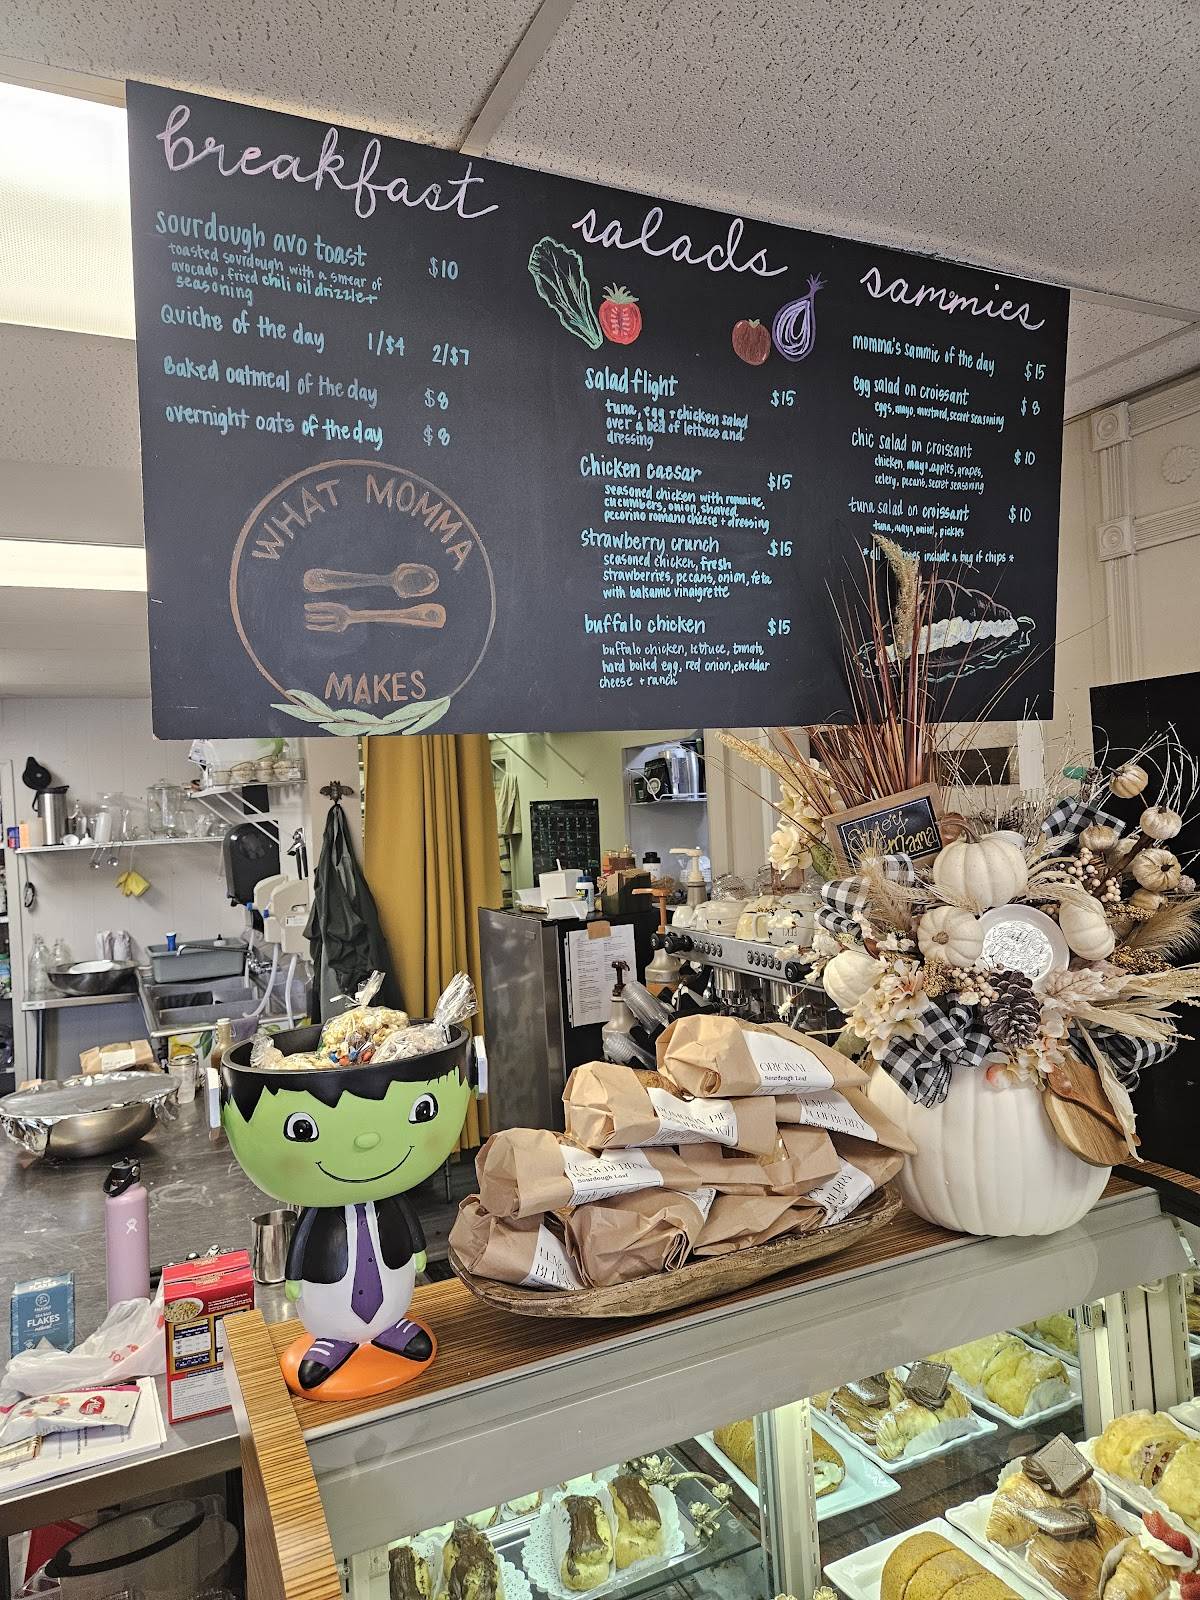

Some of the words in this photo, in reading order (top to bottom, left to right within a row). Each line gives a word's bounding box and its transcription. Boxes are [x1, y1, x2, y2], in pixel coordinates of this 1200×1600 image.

[157, 105, 499, 218] breakfast
[274, 233, 307, 256] avo
[314, 234, 367, 267] toast
[571, 206, 788, 277] salads
[168, 242, 218, 262] toasted
[223, 251, 284, 275] sourdough
[289, 264, 314, 279] with
[319, 271, 327, 280] a
[330, 272, 367, 288] smear
[371, 277, 383, 292] of
[428, 256, 459, 281] $10
[176, 275, 253, 306] seasoning
[228, 268, 258, 285] fried
[262, 274, 291, 292] chili
[296, 279, 312, 294] oil
[860, 266, 1045, 331] sammies
[161, 303, 223, 332] Quiche
[232, 309, 250, 335] of
[257, 315, 287, 340] the
[293, 322, 325, 354] day
[368, 330, 405, 357] 1/$4
[852, 334, 902, 355] momma's
[904, 343, 941, 363] sammie
[944, 346, 955, 363] of
[958, 349, 974, 369] the
[976, 352, 996, 378] day
[163, 355, 219, 382] Baked
[225, 365, 290, 393] oatmeal
[298, 373, 313, 395] of
[319, 375, 344, 398] the
[348, 378, 379, 409] day
[630, 368, 679, 401] flight
[853, 375, 871, 398] egg
[873, 376, 901, 396] salad
[904, 384, 917, 397] on
[920, 384, 970, 405] croissant
[770, 389, 797, 408] $15
[166, 404, 250, 436] overnight
[255, 412, 295, 433] oats
[302, 413, 319, 437] of
[321, 417, 351, 442] the
[353, 419, 385, 451] day
[606, 416, 633, 431] over
[636, 421, 644, 433] a
[647, 420, 666, 434] bed
[668, 421, 681, 434] of
[684, 421, 721, 440] lettuce
[721, 429, 745, 442] and
[643, 406, 665, 423] egg
[721, 413, 749, 430] salad
[949, 411, 970, 423] secret
[970, 412, 1005, 433] seasoning
[607, 430, 654, 452] dressing
[879, 432, 907, 453] salad
[911, 439, 922, 453] on
[926, 440, 973, 459] croissant
[767, 472, 793, 492] $15
[928, 478, 949, 490] secret
[949, 478, 985, 495] seasoning
[604, 484, 653, 500] seasoned
[655, 487, 696, 503] chicken
[700, 490, 724, 505] with
[848, 497, 876, 514] tuna
[877, 498, 904, 517] salad
[907, 504, 918, 517] on
[922, 503, 970, 521] croissant
[251, 478, 341, 561] WHAT
[366, 473, 473, 572] MOMMA
[604, 509, 647, 524] pecorino
[648, 511, 686, 525] romano
[687, 512, 719, 528] cheese
[727, 514, 771, 536] dressing
[939, 525, 965, 538] pickles
[671, 536, 720, 553] crunch
[767, 539, 793, 557] $15
[923, 549, 950, 563] include
[952, 554, 958, 563] a
[603, 553, 651, 568] seasoned
[654, 555, 698, 572] chicken,
[700, 556, 731, 571] fresh
[603, 568, 674, 584] strawberries,
[676, 572, 716, 586] pecans,
[718, 571, 750, 587] onion,
[751, 570, 773, 585] feta
[603, 584, 626, 599] with
[629, 585, 672, 599] balsamic
[673, 585, 730, 602] vinaigrette
[584, 613, 642, 634] buffalo
[647, 614, 706, 635] chicken
[767, 617, 791, 637] $15
[602, 640, 642, 656] buffalo
[644, 642, 688, 657] chicken,
[602, 658, 625, 673] hard
[629, 656, 657, 672] boiled
[661, 660, 683, 677] egg,
[685, 658, 701, 673] red
[733, 658, 771, 673] cheddar
[325, 670, 426, 705] MAKES
[599, 675, 634, 689] cheese
[647, 673, 678, 687] ranch
[27, 1313, 60, 1328] FLAKES
